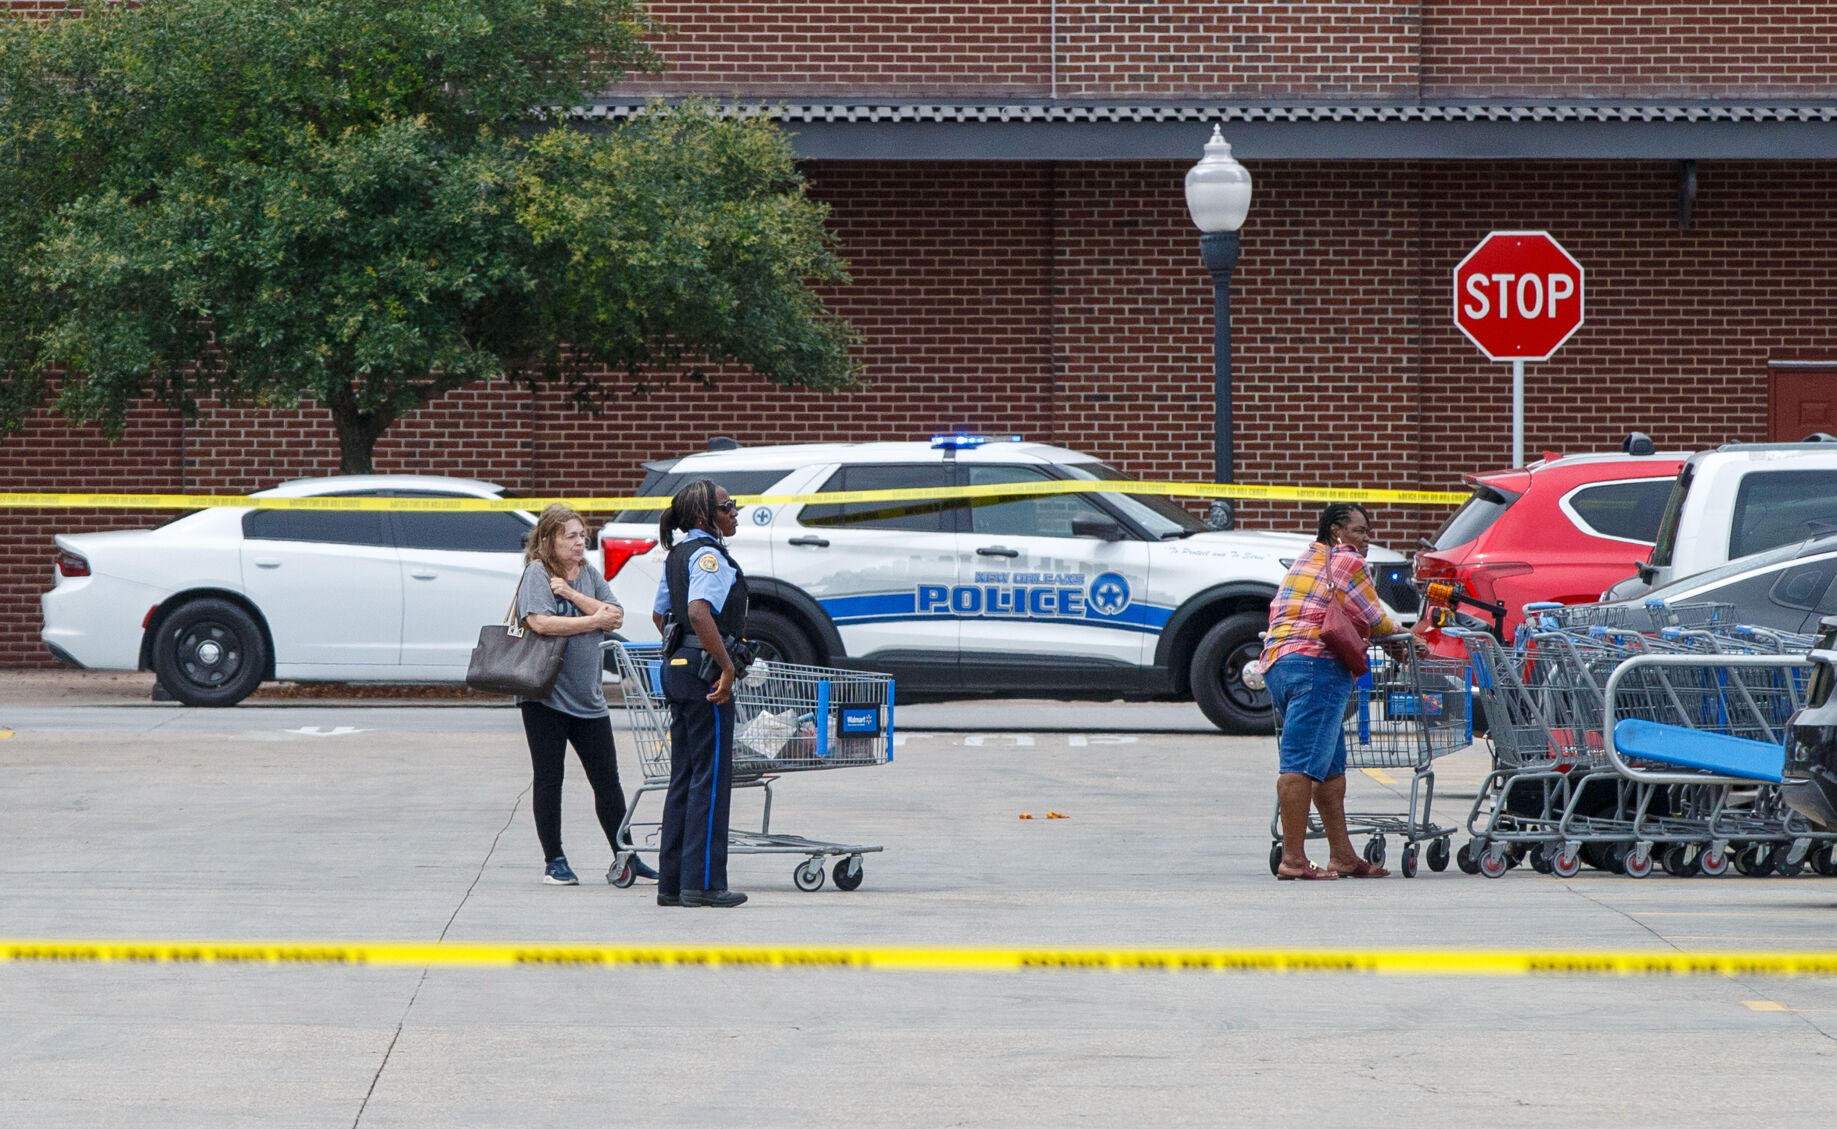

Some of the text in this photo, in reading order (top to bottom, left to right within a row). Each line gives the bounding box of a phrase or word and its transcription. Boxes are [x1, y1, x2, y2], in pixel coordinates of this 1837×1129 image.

[1464, 273, 1574, 319] STOP
[975, 571, 1085, 585] NEW ORLEANS
[917, 584, 1087, 617] POLICE
